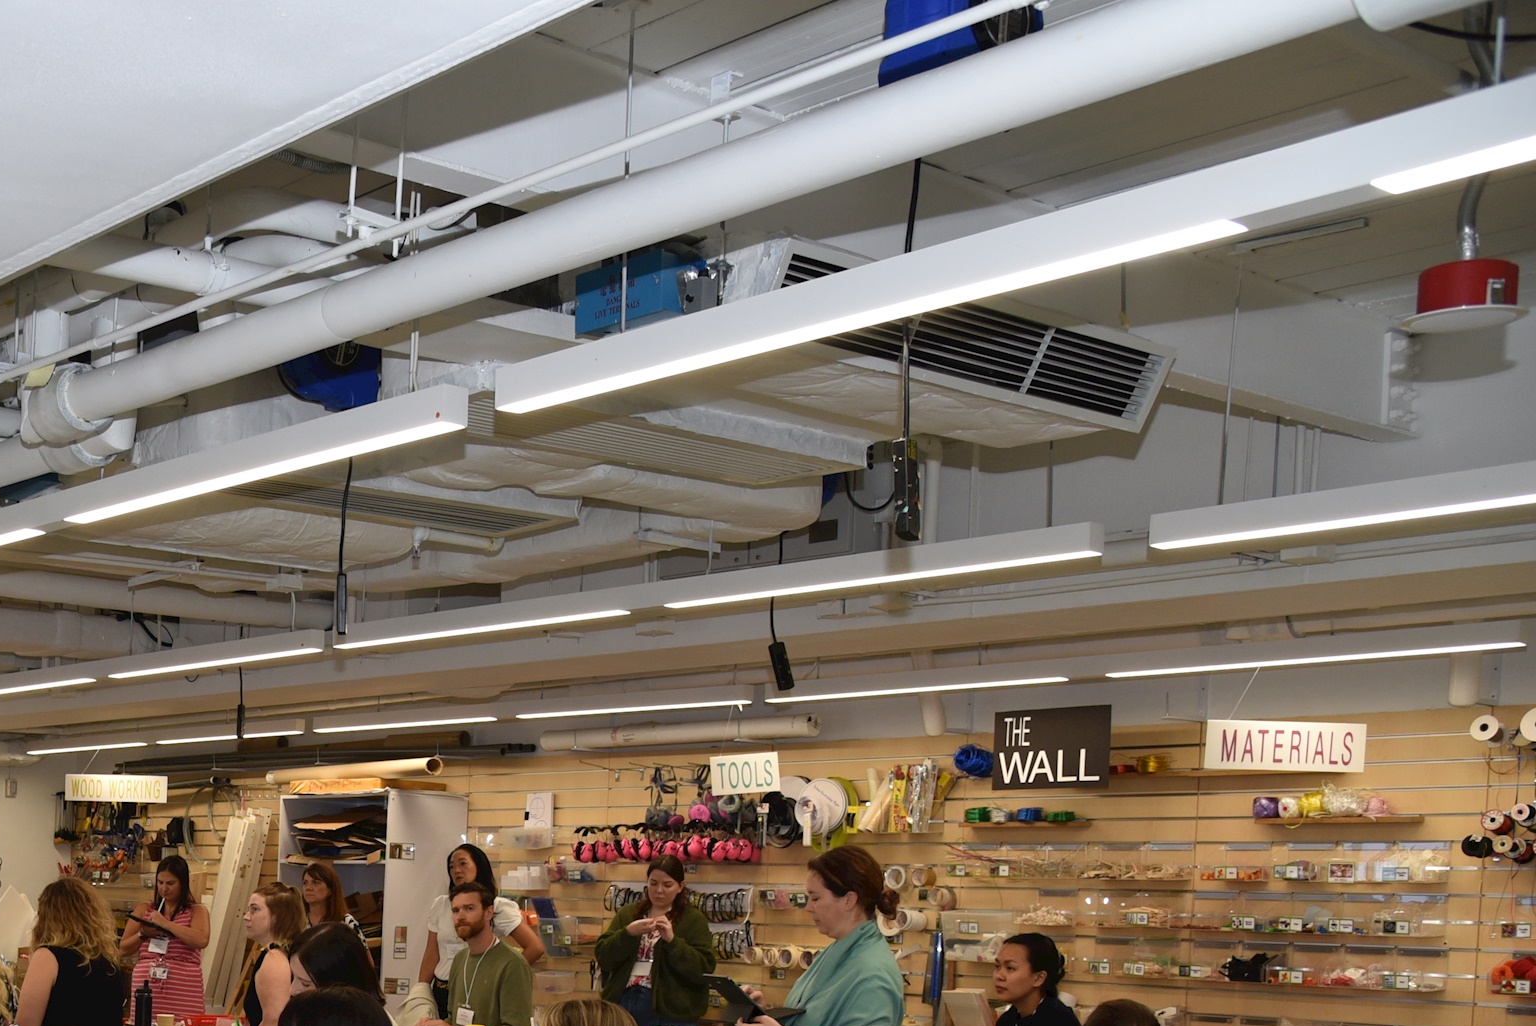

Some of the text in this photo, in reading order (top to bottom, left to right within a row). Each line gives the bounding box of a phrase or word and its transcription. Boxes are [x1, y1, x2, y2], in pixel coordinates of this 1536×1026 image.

[594, 299, 641, 320] LIVE TERNALS
[1004, 716, 1032, 748] THE
[1220, 728, 1354, 766] MATERIALS
[716, 759, 774, 790] TOOLS
[998, 748, 1101, 785] WALL
[71, 778, 161, 799] WOOD WORKING
